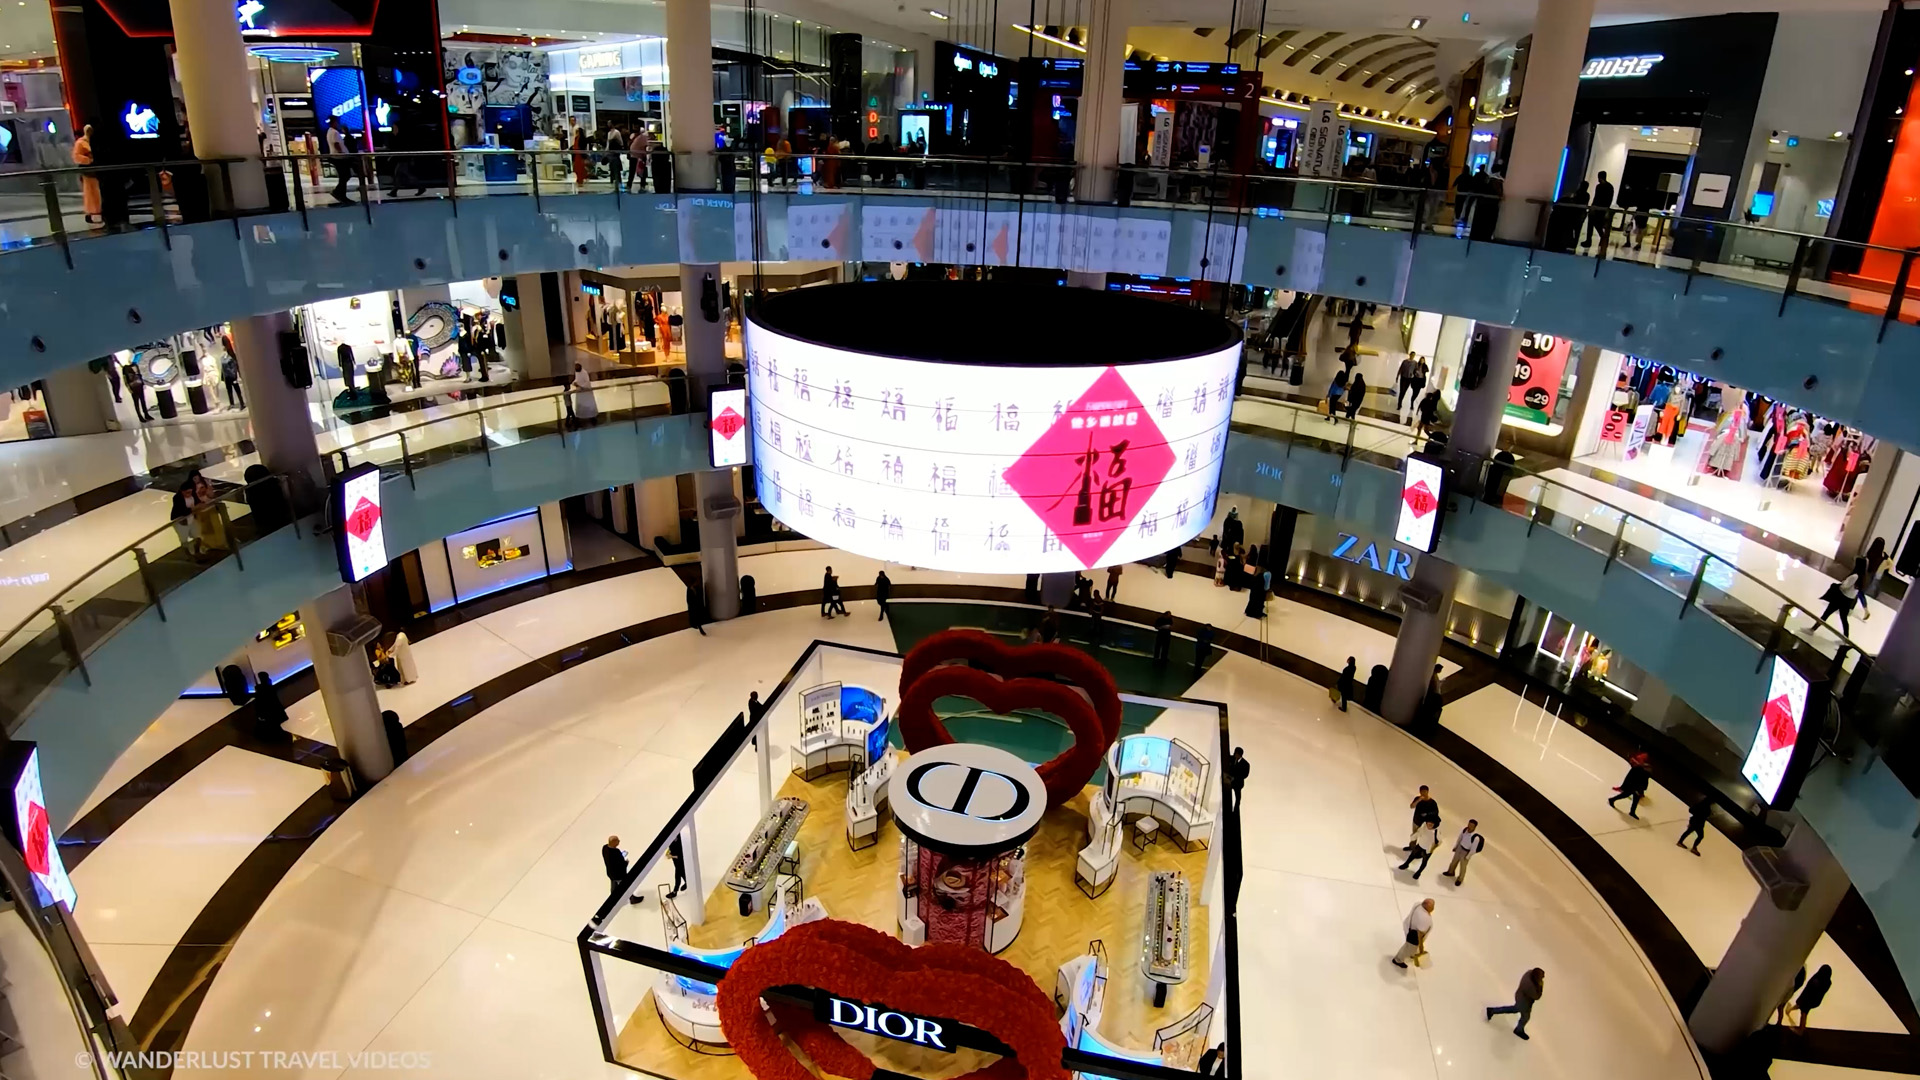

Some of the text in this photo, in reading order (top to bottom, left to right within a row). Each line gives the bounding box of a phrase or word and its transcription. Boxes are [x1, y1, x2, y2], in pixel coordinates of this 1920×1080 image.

[580, 50, 620, 69] GAMING
[1579, 54, 1664, 78] BOSE
[1244, 83, 1255, 98] 2
[1322, 109, 1332, 124] LG
[1533, 332, 1554, 352] 10
[1514, 363, 1531, 380] 19
[1534, 393, 1549, 405] 29
[1045, 431, 1133, 527] 福
[1332, 532, 1413, 581] ZAR
[829, 998, 947, 1050] DIOR
